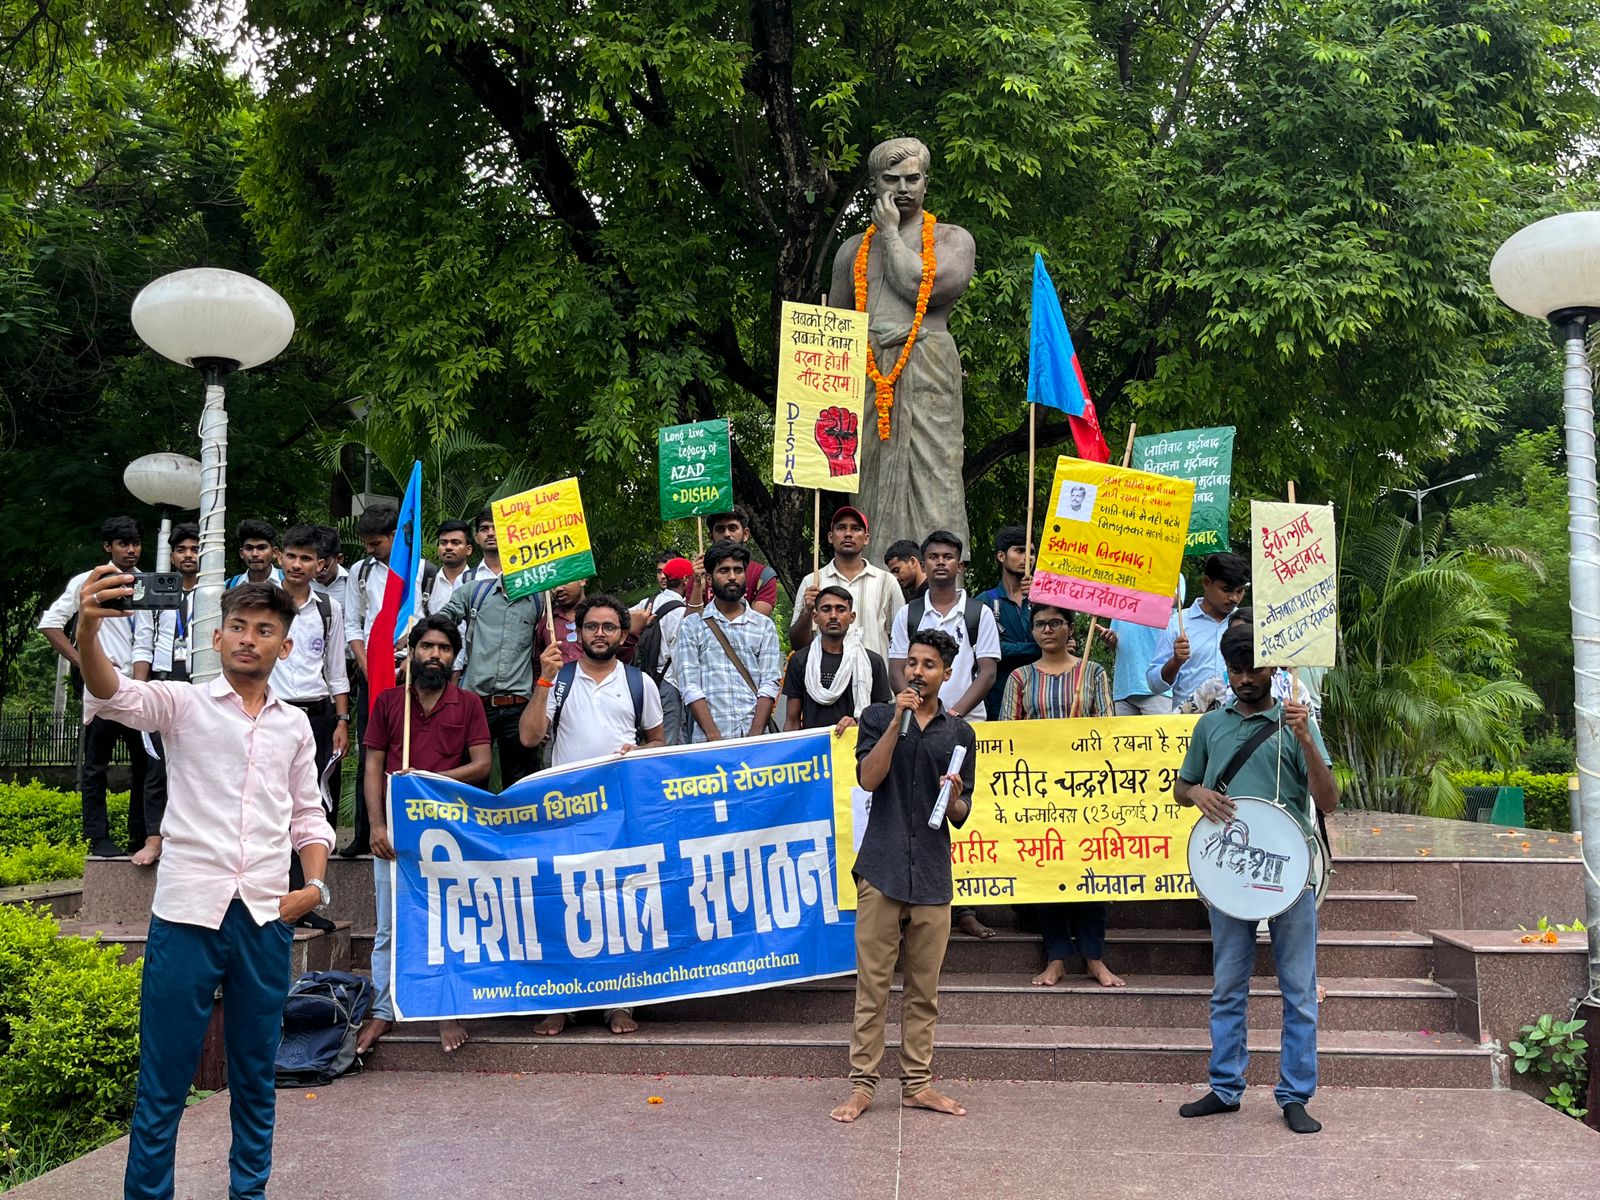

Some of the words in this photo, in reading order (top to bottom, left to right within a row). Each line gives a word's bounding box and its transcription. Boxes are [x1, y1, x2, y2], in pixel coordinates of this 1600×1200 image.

[791, 308, 822, 328] सबको
[792, 329, 825, 346] सबको
[794, 350, 823, 367] वरना
[825, 350, 851, 372] होगी
[664, 429, 684, 445] Long
[708, 441, 718, 456] of
[783, 402, 800, 484] DISHA
[1187, 434, 1220, 454] मुर्दाबाद
[670, 462, 705, 480] AZAD
[1184, 453, 1219, 473] मुर्दाबाद
[500, 500, 531, 517] Long
[535, 492, 560, 505] Live
[680, 486, 720, 503] DISHA
[507, 511, 584, 544] REVOLUTION
[518, 534, 575, 566] DISHA
[1040, 573, 1069, 595] दिशा
[1058, 558, 1091, 577] नौजवान
[1092, 569, 1114, 581] भारत
[1116, 573, 1136, 587] सभा
[1261, 628, 1288, 655] दिशा
[1071, 729, 1102, 752] जारी
[1113, 736, 1153, 752] रखना
[1155, 727, 1170, 752] है
[661, 765, 728, 800] सबको
[732, 754, 831, 791] रोजगार!!
[989, 758, 1047, 798] शहीद
[1054, 760, 1150, 798] चन्द्रशेखर
[404, 798, 469, 823] सबको
[472, 804, 538, 826] समान
[543, 786, 609, 821] शिक्षा!
[994, 802, 1007, 824] के
[1015, 802, 1078, 823] जन्मदिवस
[1164, 804, 1181, 819] पर
[950, 830, 999, 864] शहीद
[1013, 827, 1067, 867] स्मृति
[1079, 826, 1173, 862] अभियान
[418, 828, 543, 965] दिशा
[553, 843, 669, 958] छात्र
[679, 800, 840, 941] संगठन
[955, 870, 1017, 897] संगठन
[1076, 867, 1147, 894] नौजवान
[472, 951, 800, 1001] www.facebook.com/dishachhatrasangathan
